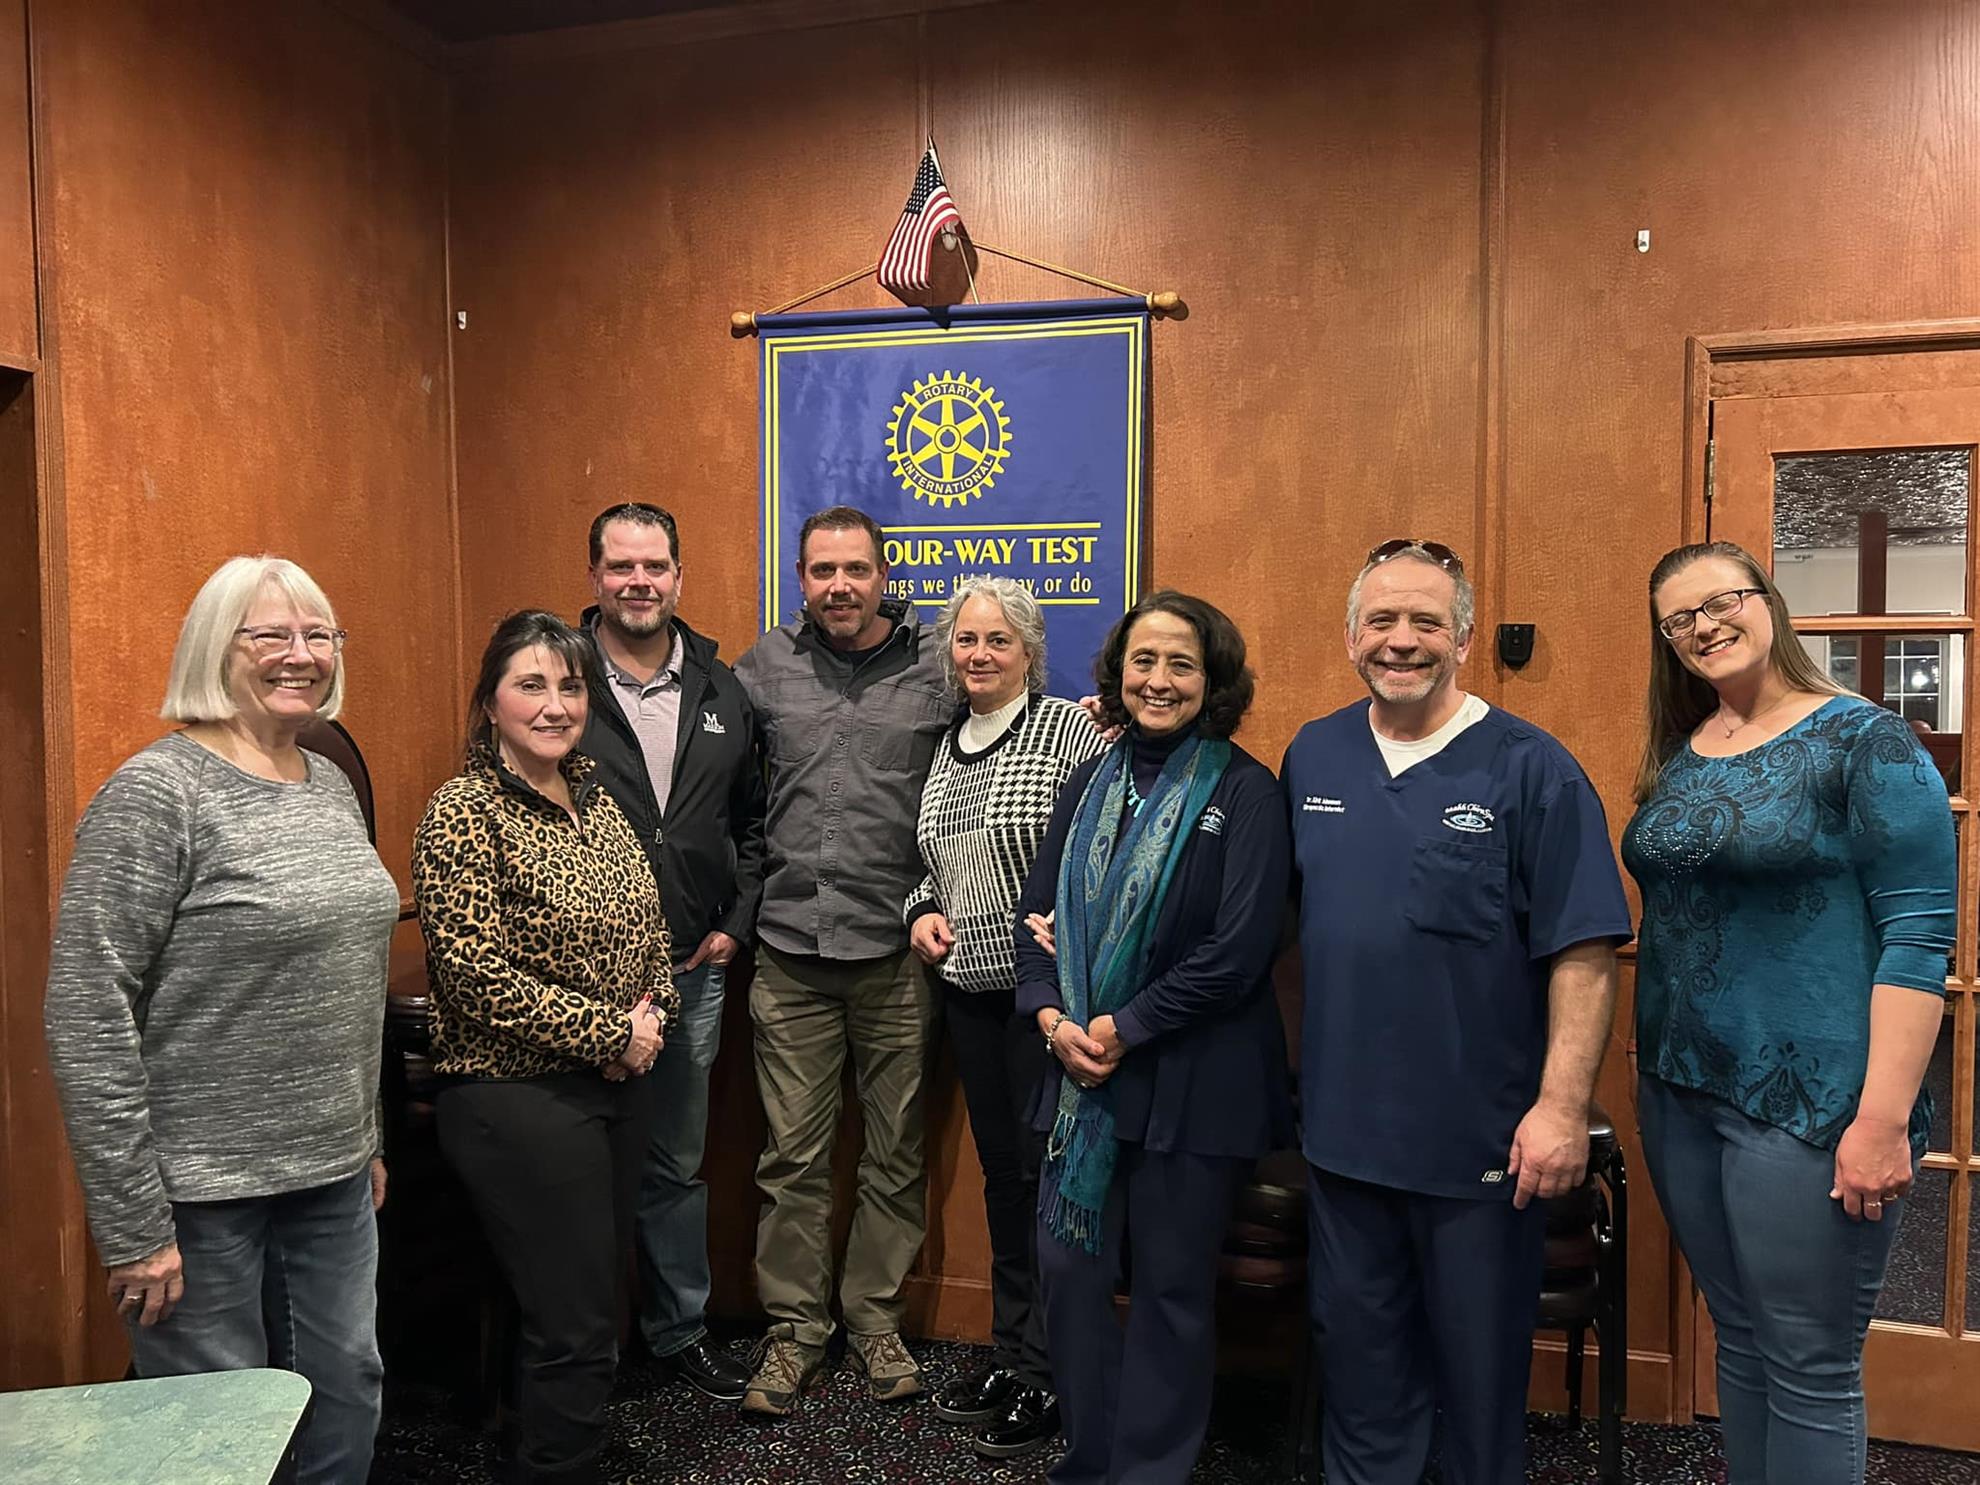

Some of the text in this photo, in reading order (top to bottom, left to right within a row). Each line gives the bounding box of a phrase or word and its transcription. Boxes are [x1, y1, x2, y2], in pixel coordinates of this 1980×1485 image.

[922, 384, 974, 400] ROTARY
[902, 458, 994, 494] INTERNATIONAL
[883, 536, 1098, 566] OUR-WAY TEST
[922, 579, 945, 594] we
[1044, 578, 1063, 593] or
[1070, 571, 1092, 593] do
